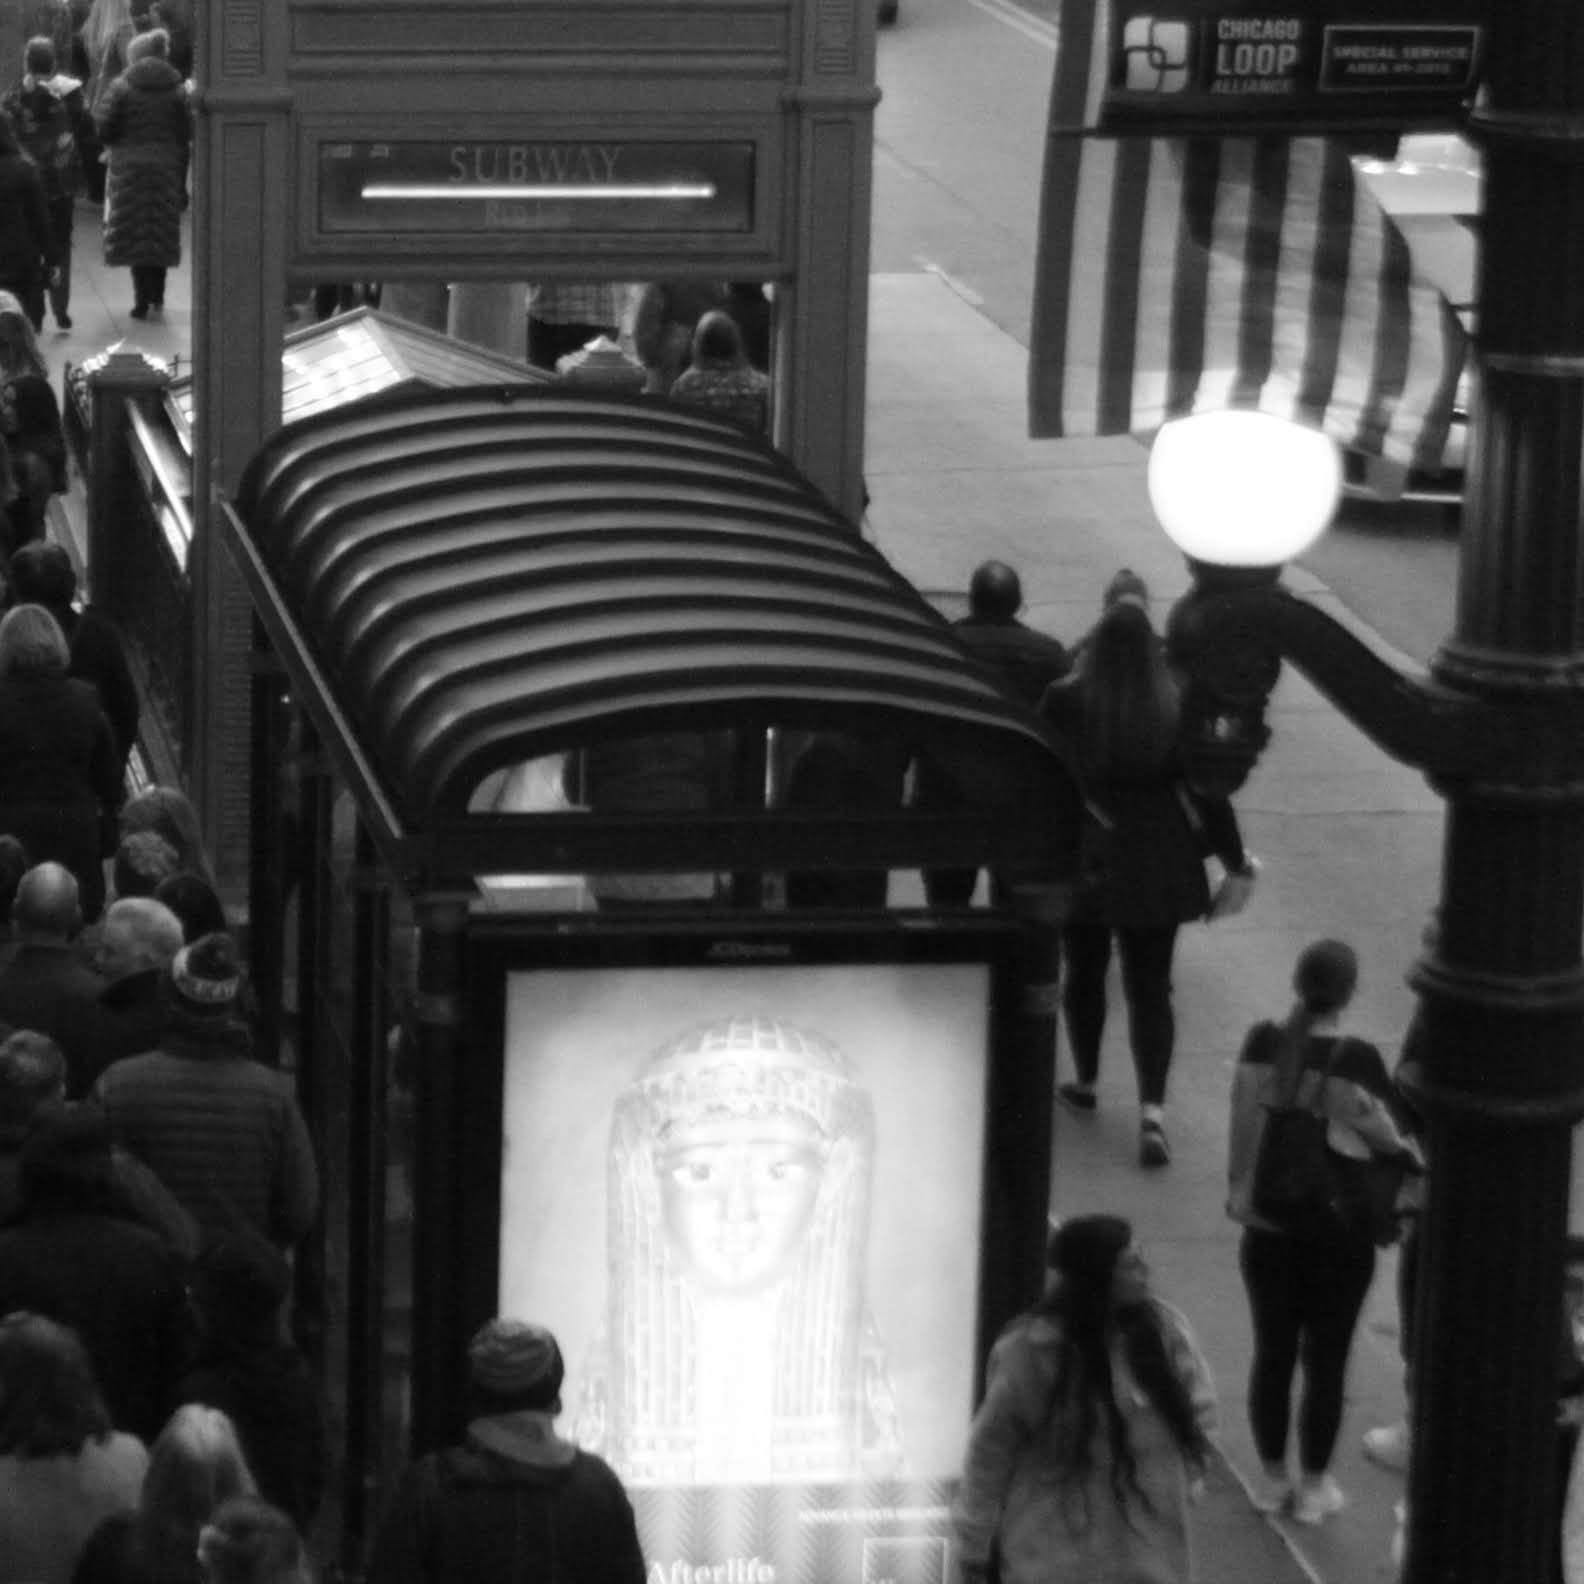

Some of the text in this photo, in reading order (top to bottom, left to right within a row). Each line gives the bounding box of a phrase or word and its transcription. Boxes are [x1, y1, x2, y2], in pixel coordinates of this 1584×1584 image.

[1218, 19, 1300, 40] CHICAGO
[1217, 44, 1299, 75] LOOP
[1212, 78, 1294, 95] ALLIANCE
[449, 146, 622, 184] SUBWAY
